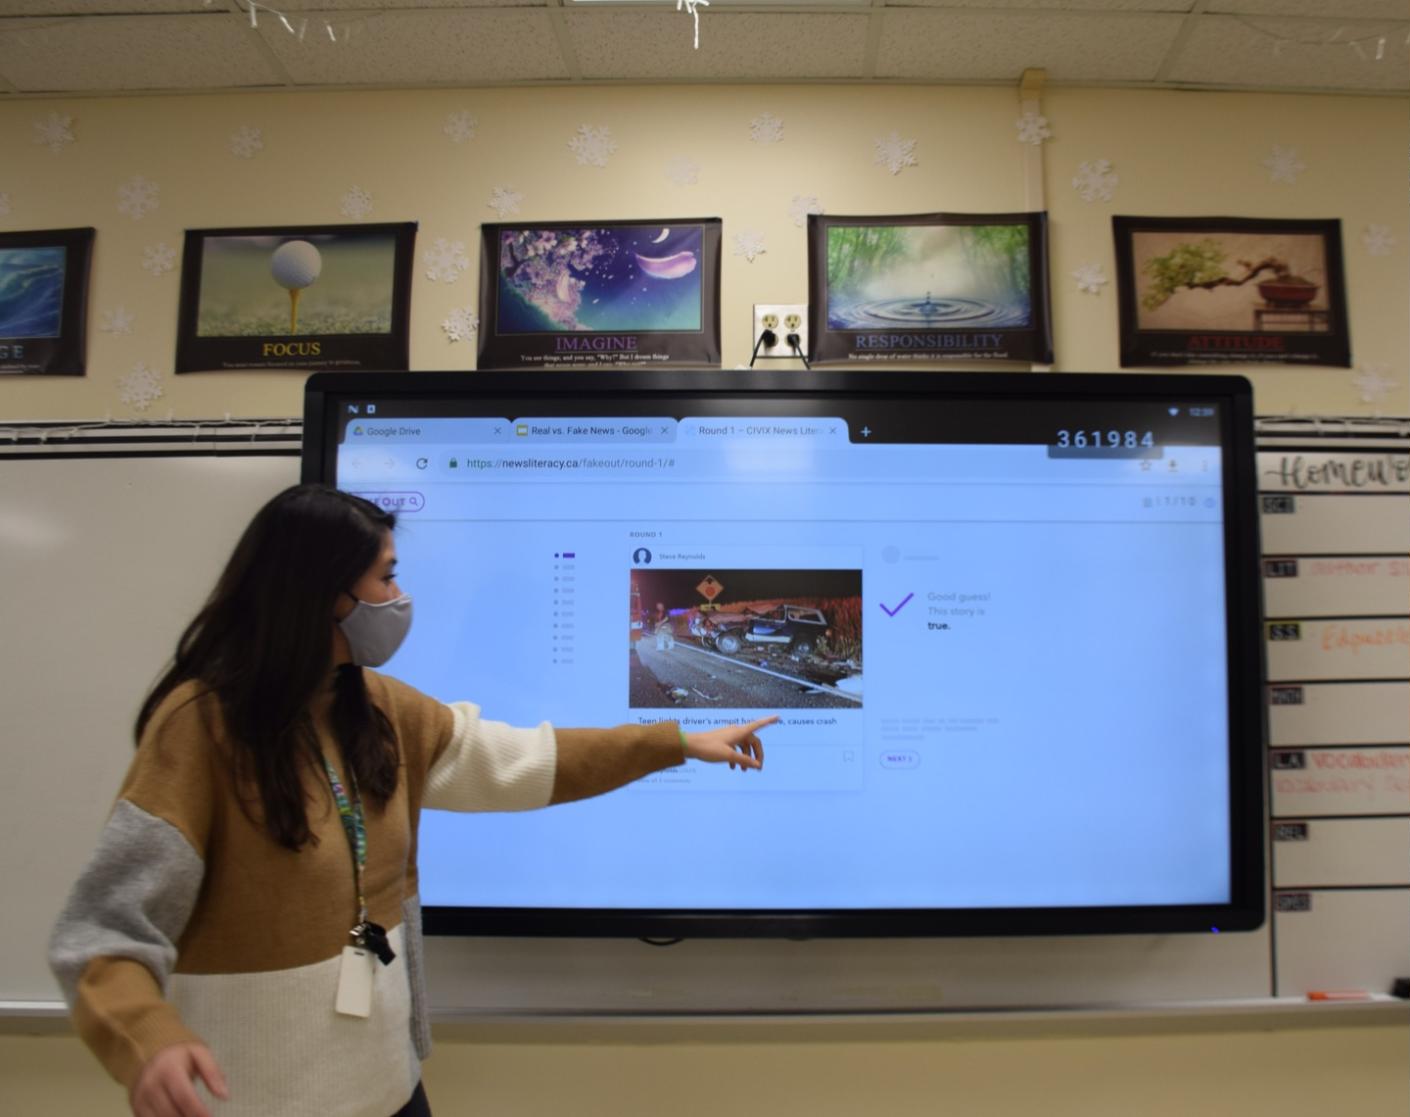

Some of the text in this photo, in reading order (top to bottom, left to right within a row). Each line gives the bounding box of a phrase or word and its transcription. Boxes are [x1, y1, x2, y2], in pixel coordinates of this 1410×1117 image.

[556, 336, 637, 350] IMAGINE
[855, 334, 1004, 348] RESPONSIBILITY
[263, 342, 321, 356] FOCUS
[367, 426, 421, 437] Google Drive
[531, 426, 549, 435] Real
[567, 426, 588, 435] Fake
[590, 426, 614, 435] News
[699, 426, 727, 435] Round
[746, 426, 770, 435] CIVIX
[773, 426, 798, 435] News
[1057, 430, 1154, 449] 361984
[927, 592, 991, 603] Good guess!
[928, 607, 985, 617] This story is
[927, 621, 951, 630] true.
[638, 717, 656, 725] Teen
[683, 717, 711, 726] driver's
[713, 717, 739, 727] armpit
[788, 718, 814, 726] causes
[816, 717, 837, 726] crash
